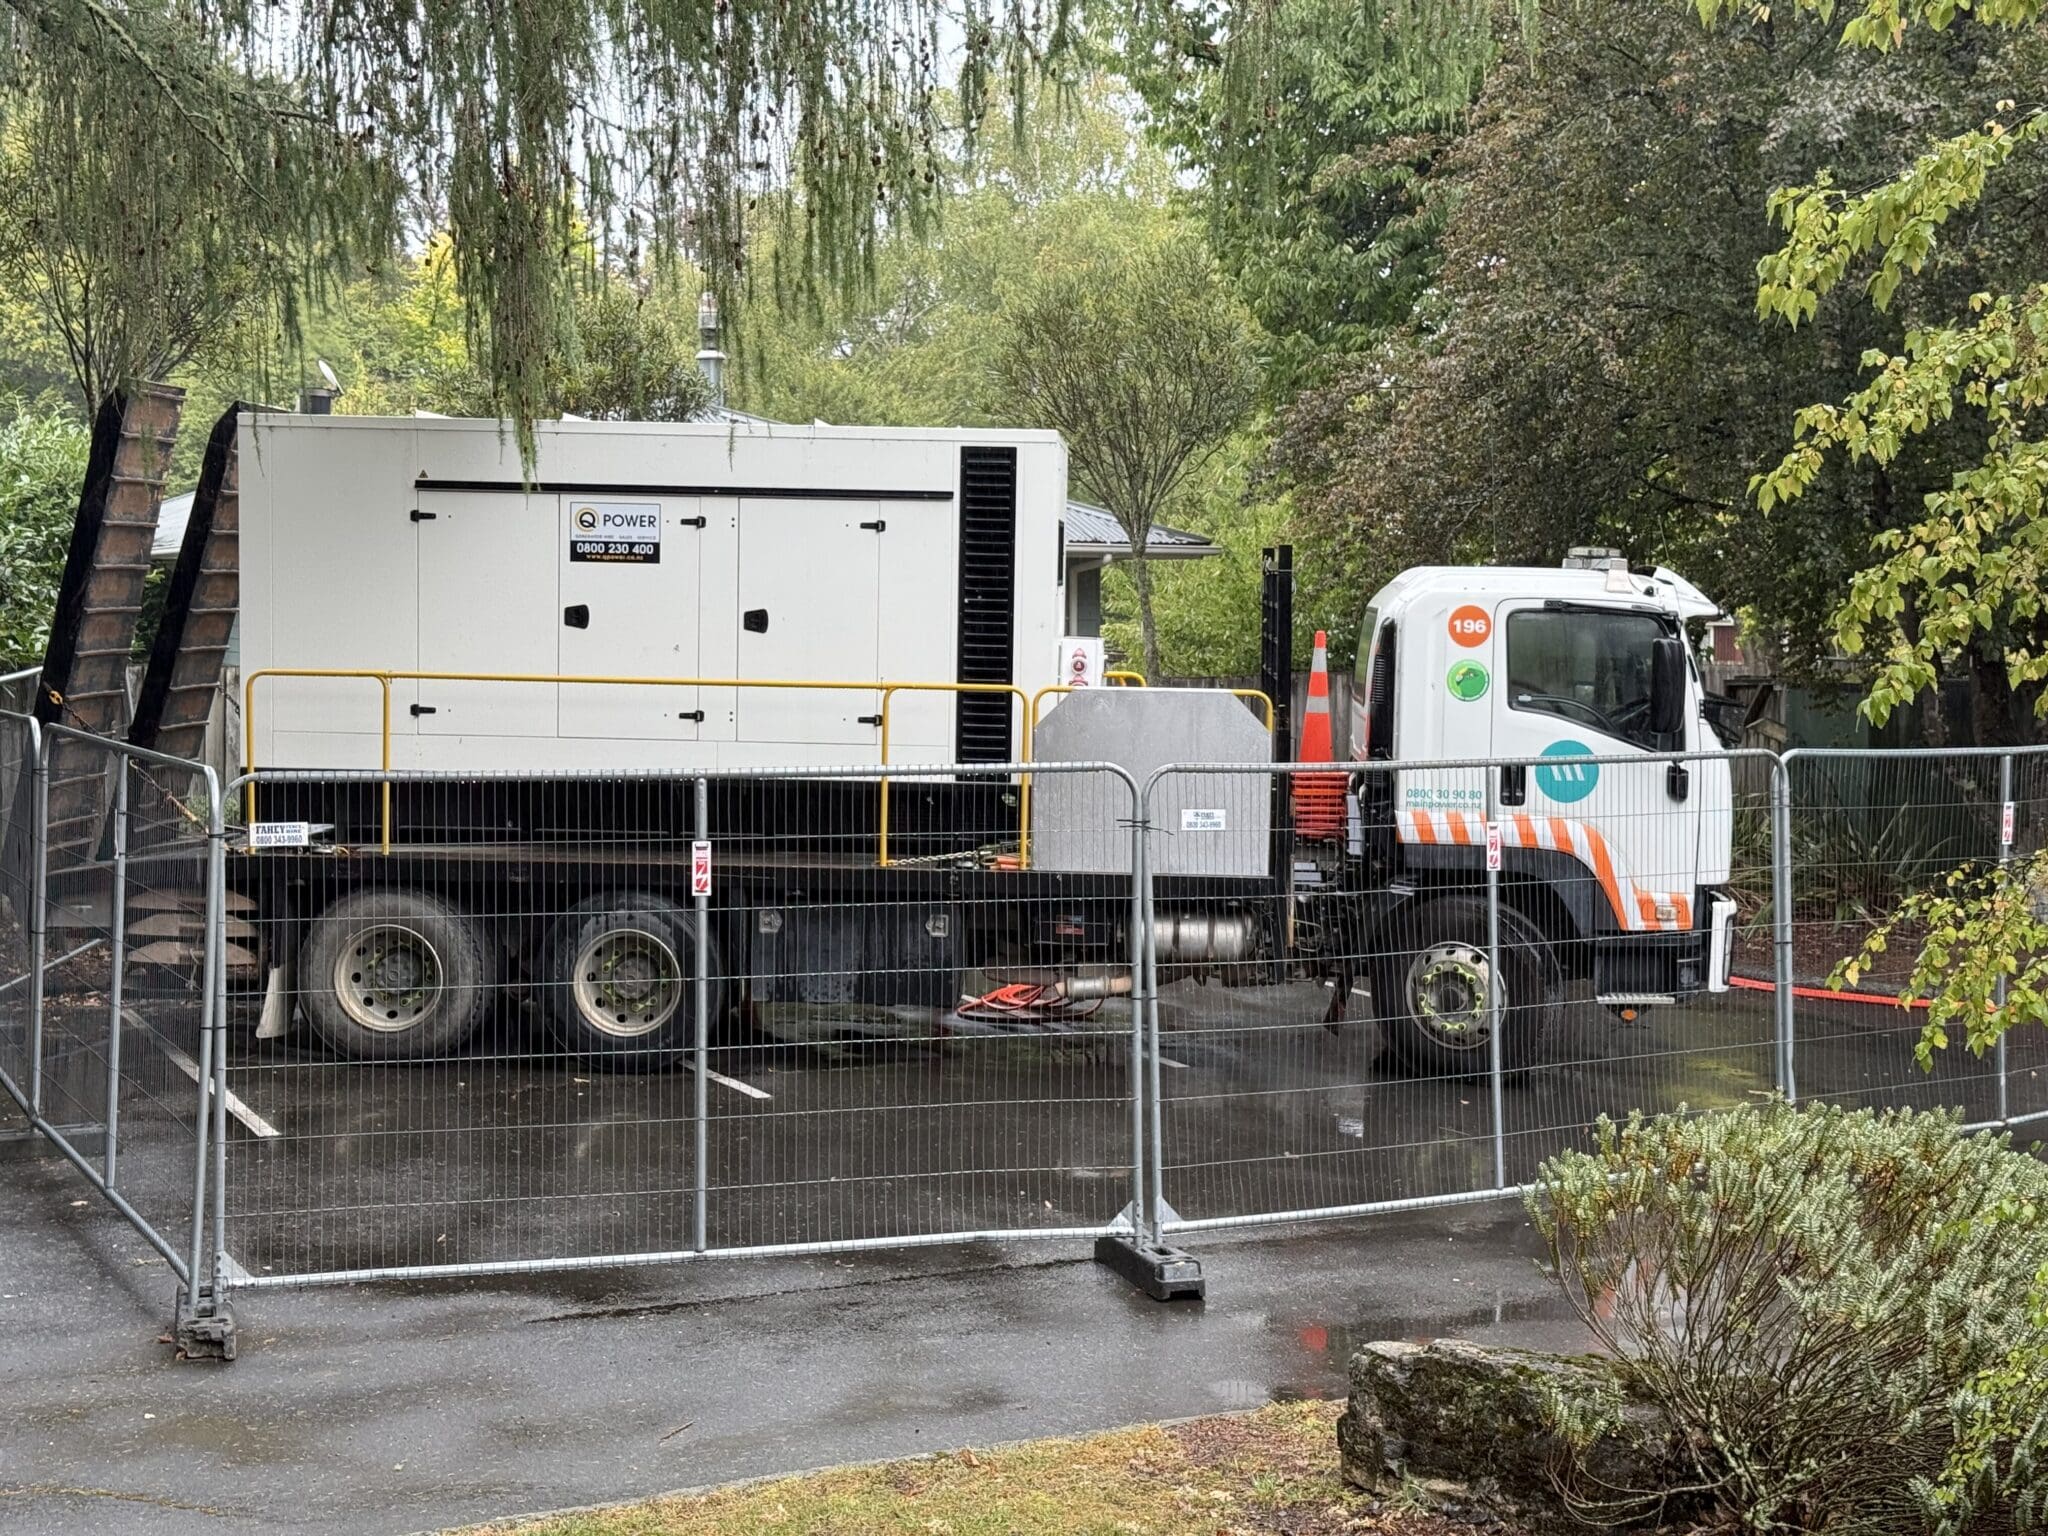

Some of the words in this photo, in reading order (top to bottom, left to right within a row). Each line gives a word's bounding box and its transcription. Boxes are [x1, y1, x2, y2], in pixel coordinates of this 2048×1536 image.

[579, 511, 597, 528] Q
[603, 514, 657, 528] POWER
[576, 542, 605, 554] 0800
[608, 543, 629, 555] 230
[632, 544, 654, 555] 400
[1453, 619, 1487, 633] 196
[1406, 788, 1433, 799] 0800
[1436, 789, 1450, 799] 30
[1452, 789, 1466, 800] 90
[1468, 790, 1483, 800] 80
[255, 825, 285, 834] FAHEY
[255, 835, 273, 845] 0800
